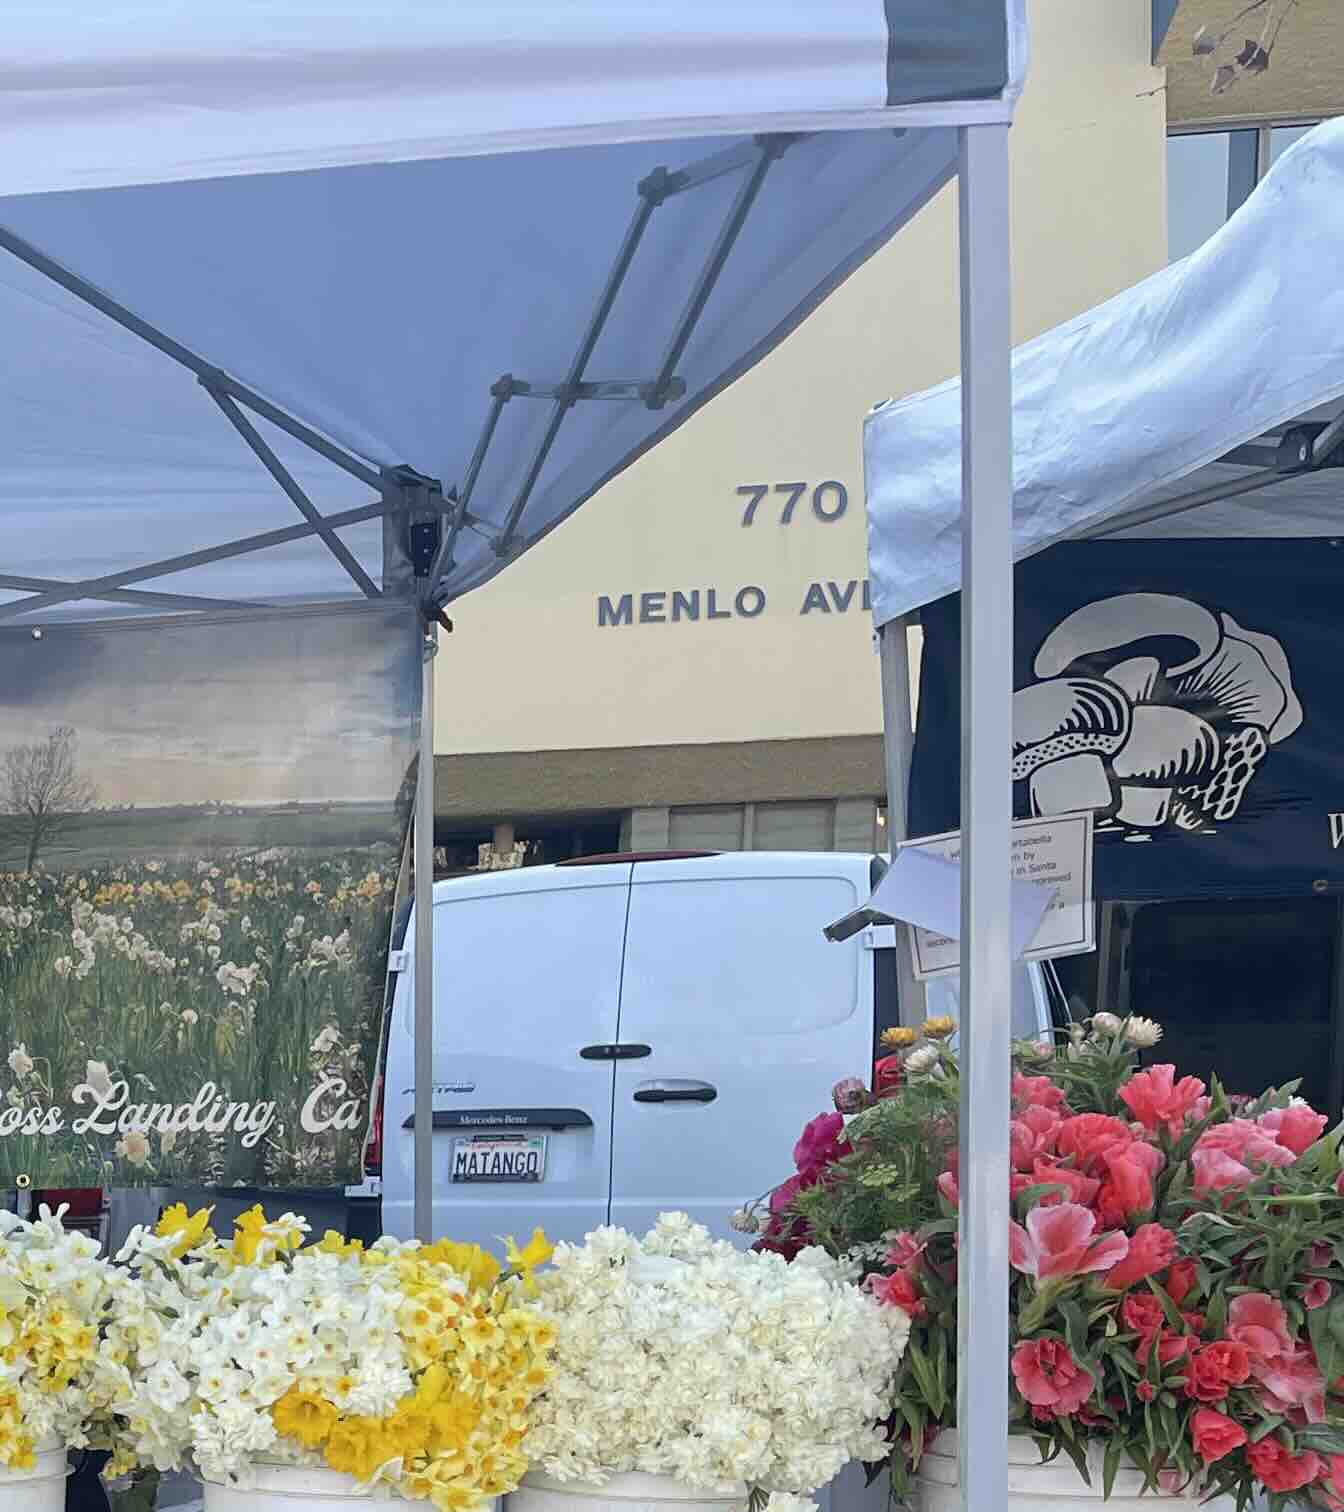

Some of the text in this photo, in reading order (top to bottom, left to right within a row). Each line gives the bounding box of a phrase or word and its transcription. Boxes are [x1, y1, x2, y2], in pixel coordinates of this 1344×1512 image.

[736, 480, 848, 527] 770
[597, 585, 767, 627] MENLO
[72, 1080, 285, 1148] Landing,
[300, 1076, 362, 1133] Ca
[455, 1152, 539, 1175] MATANGO
